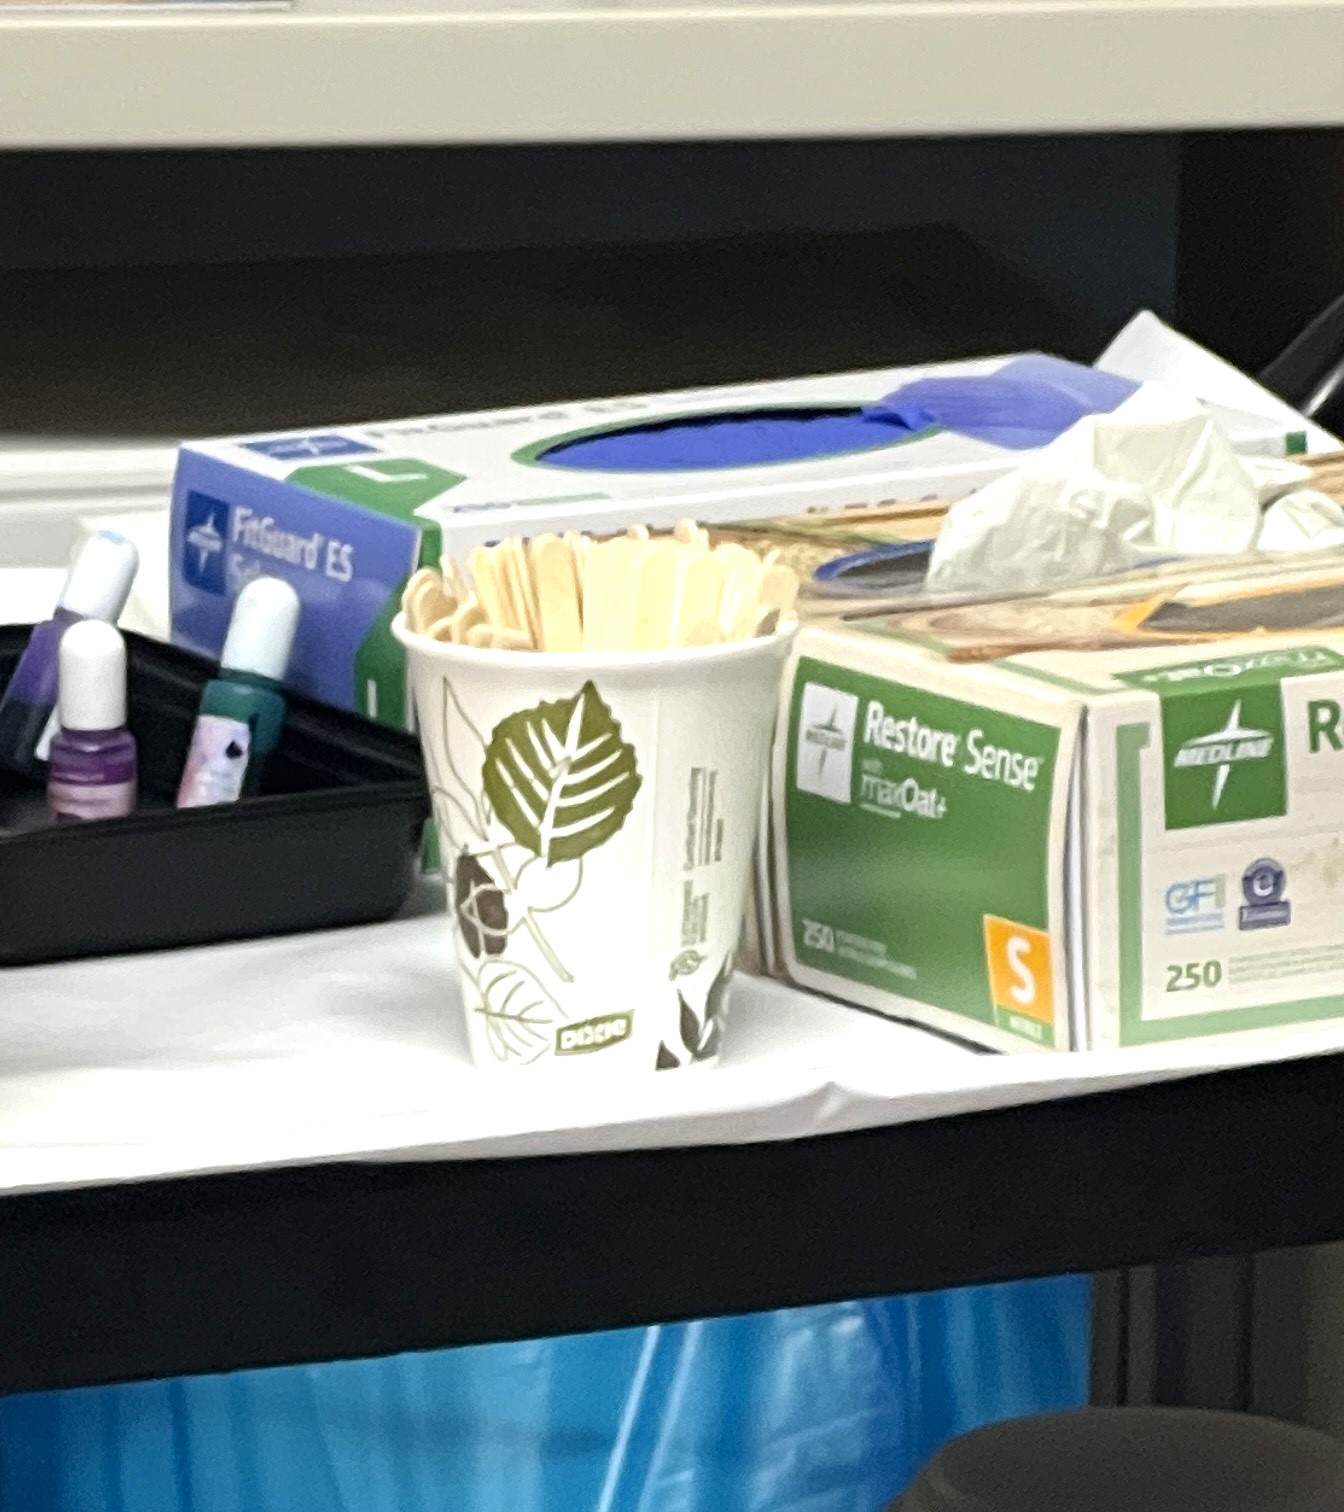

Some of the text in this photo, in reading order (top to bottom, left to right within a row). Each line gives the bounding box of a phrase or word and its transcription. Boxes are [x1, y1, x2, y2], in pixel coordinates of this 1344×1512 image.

[325, 539, 354, 583] ES
[863, 700, 1039, 792] Restore Sense
[1307, 699, 1344, 754] R
[1006, 935, 1035, 1004] S
[1166, 959, 1222, 992] 250
